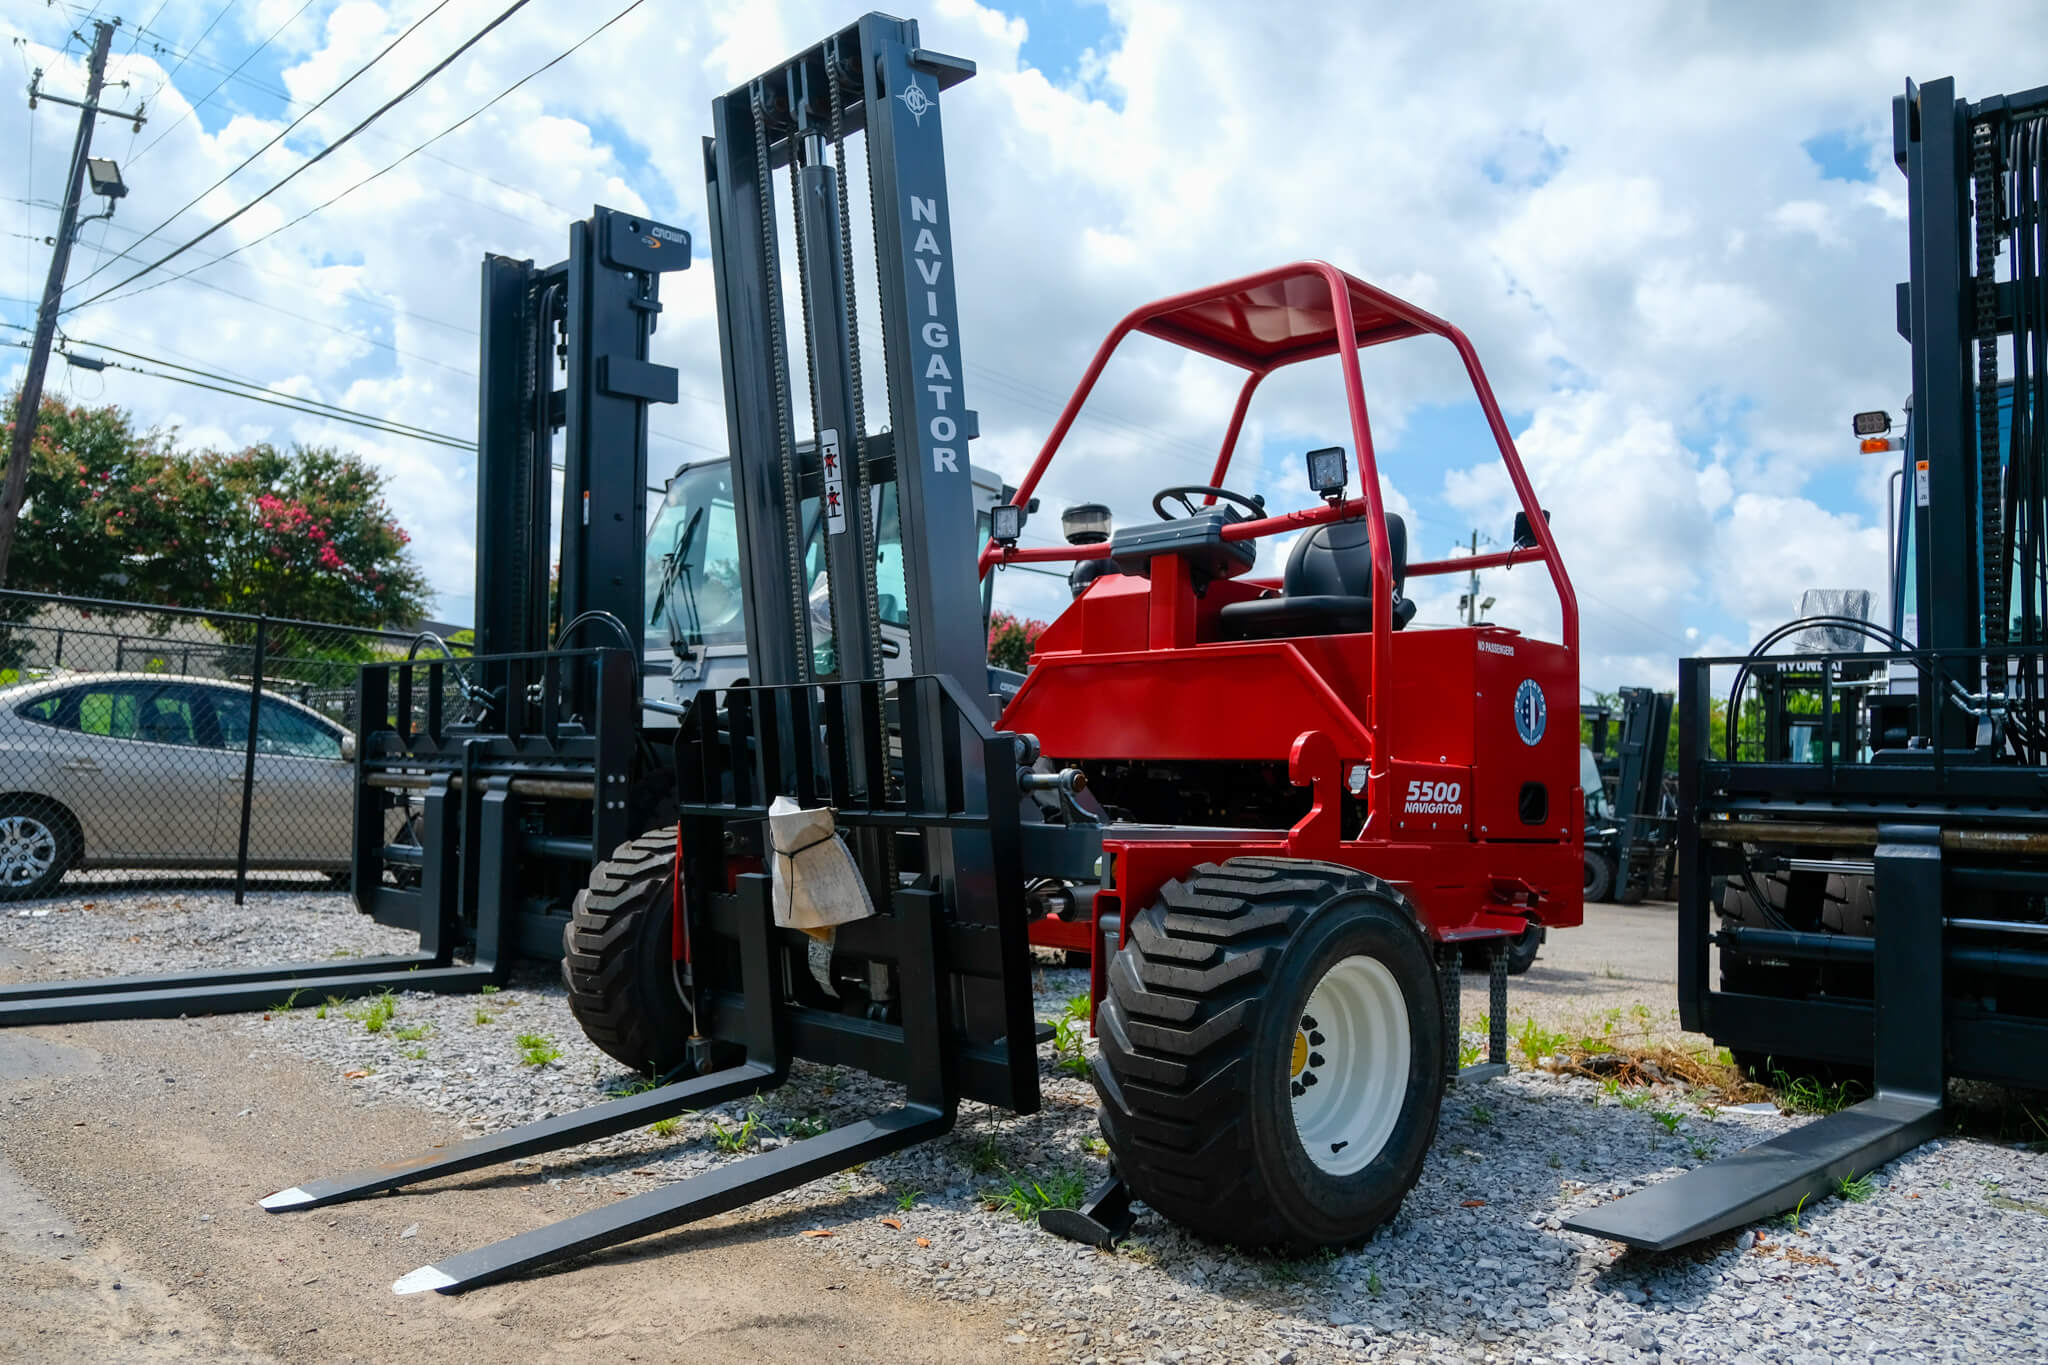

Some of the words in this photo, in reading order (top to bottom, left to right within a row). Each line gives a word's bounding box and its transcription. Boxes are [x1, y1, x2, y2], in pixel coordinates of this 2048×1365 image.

[651, 226, 687, 246] CROWN
[910, 195, 959, 473] NAVIGATOR
[1406, 780, 1460, 802] 5500
[1404, 802, 1462, 814] NAVIGATOR
